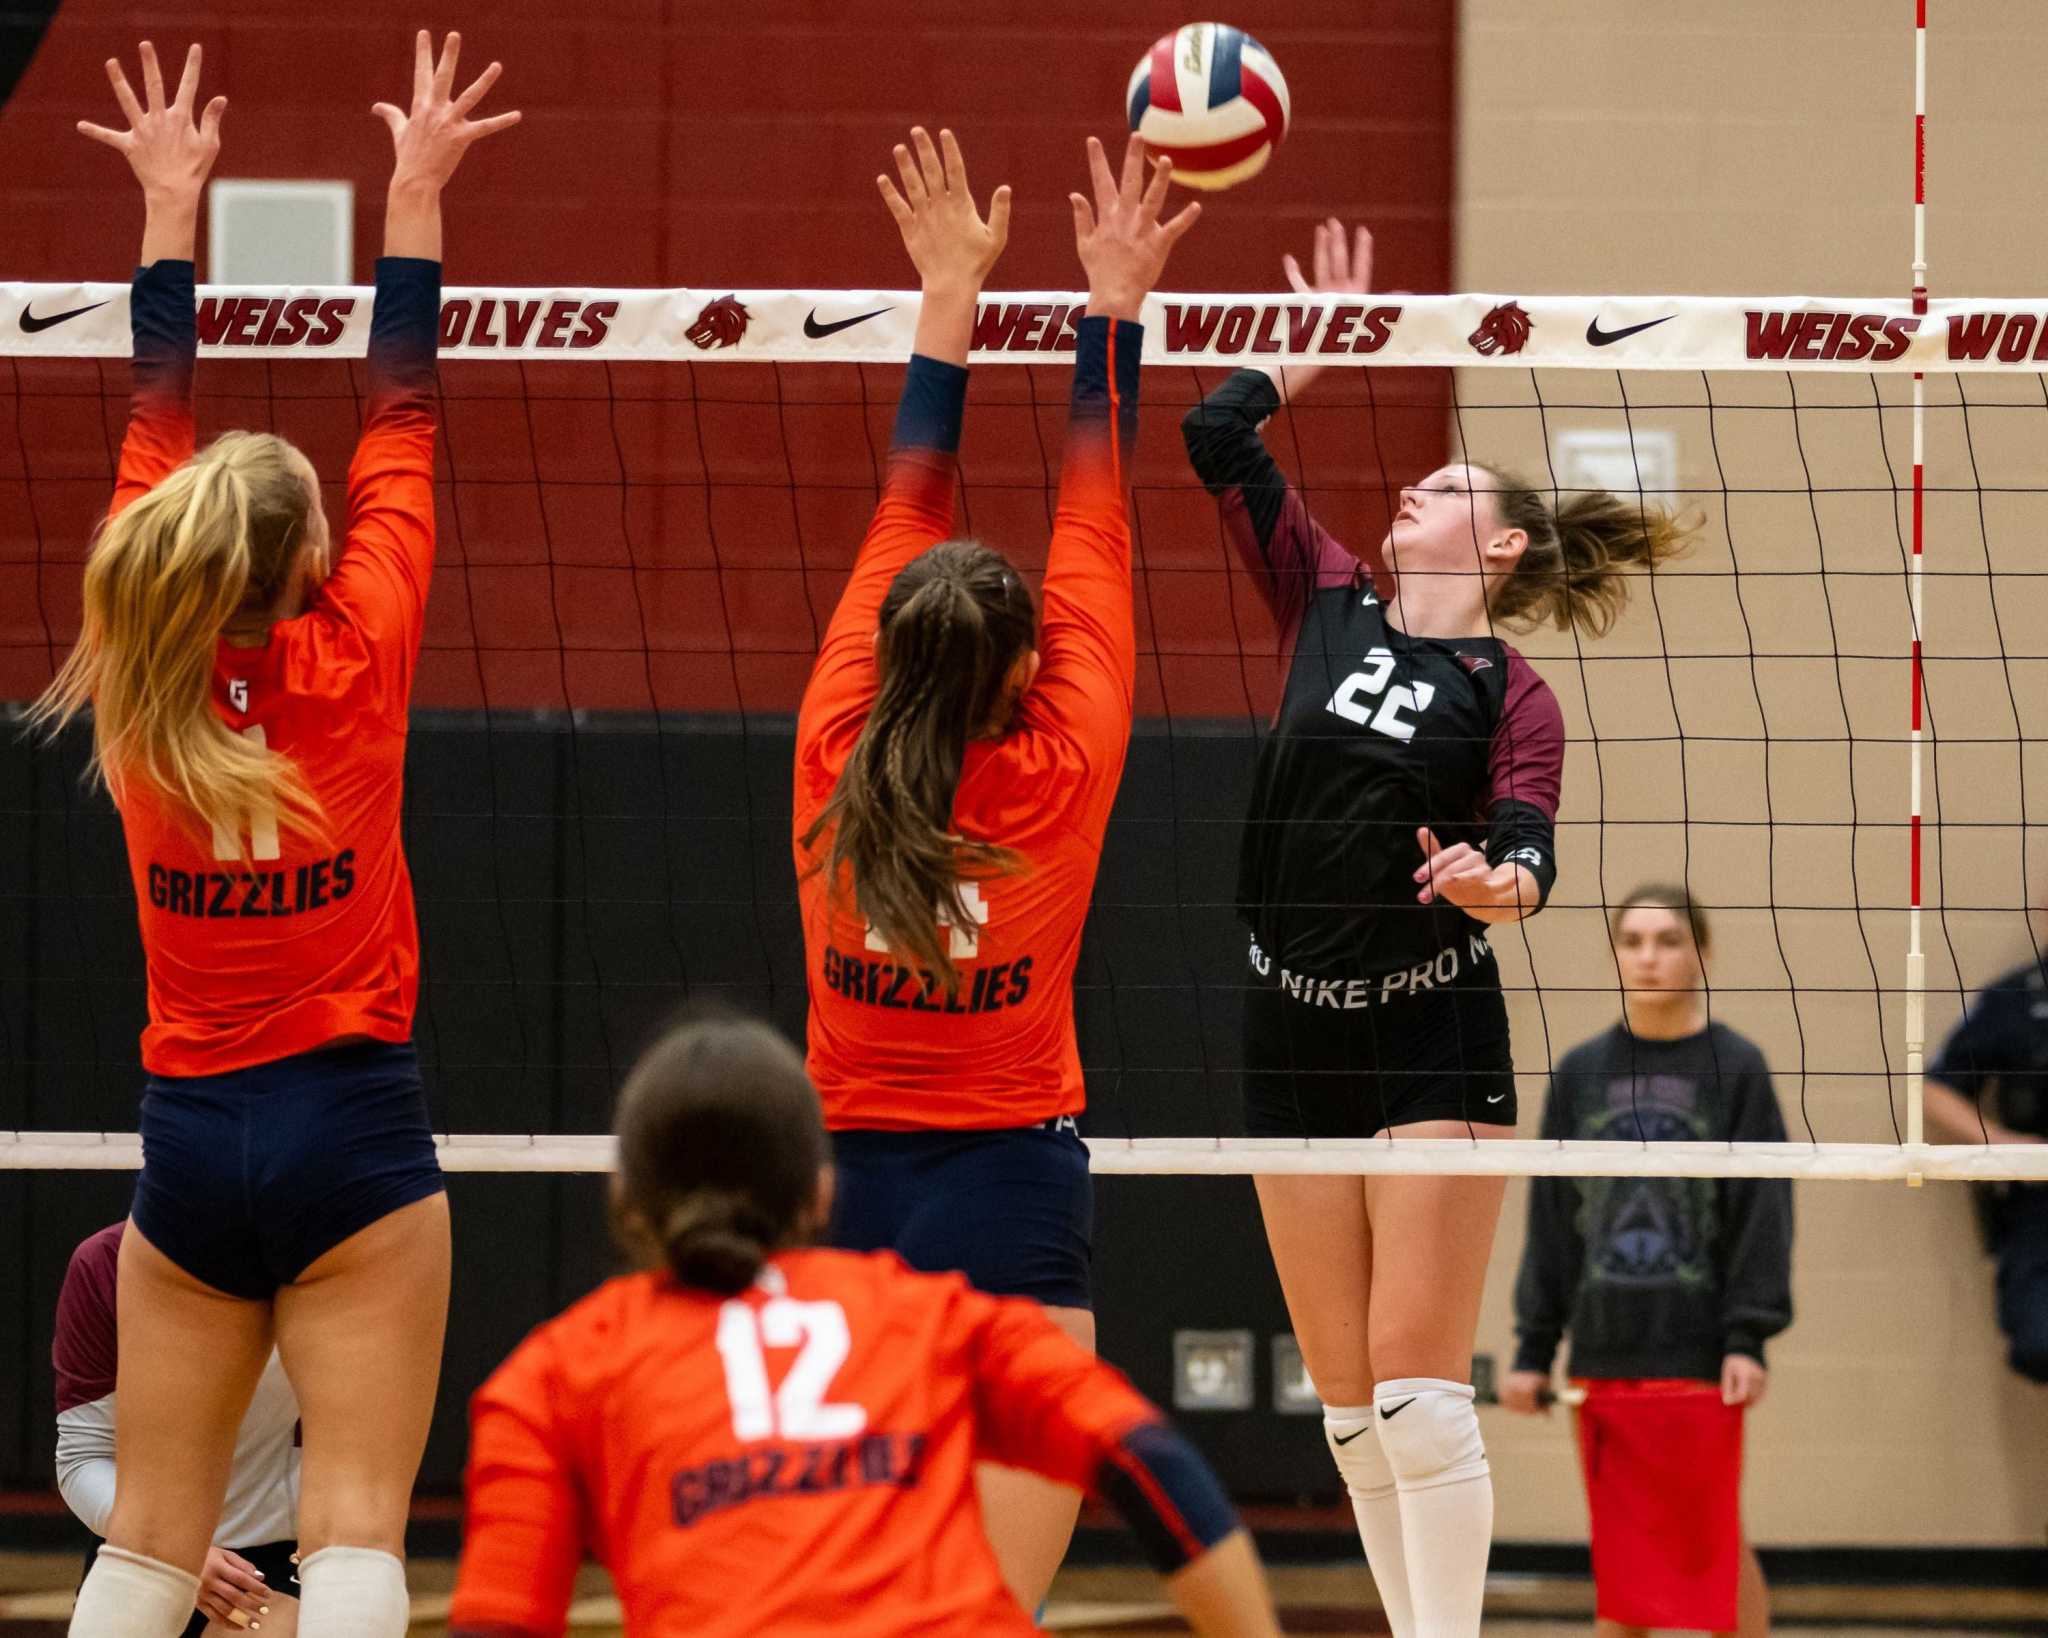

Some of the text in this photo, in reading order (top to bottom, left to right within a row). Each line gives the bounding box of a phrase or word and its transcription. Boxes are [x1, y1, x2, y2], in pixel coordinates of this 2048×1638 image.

[439, 298, 619, 349] OLVES
[1164, 304, 1402, 354] WOLVES
[1744, 311, 2048, 362] WEISS WO
[229, 679, 248, 713] G
[1325, 647, 1436, 744] 22
[148, 848, 356, 919] GRIZZLIES
[1280, 968, 1371, 1010] NIKE
[1380, 947, 1459, 1005] PRO
[714, 1297, 869, 1442] 12
